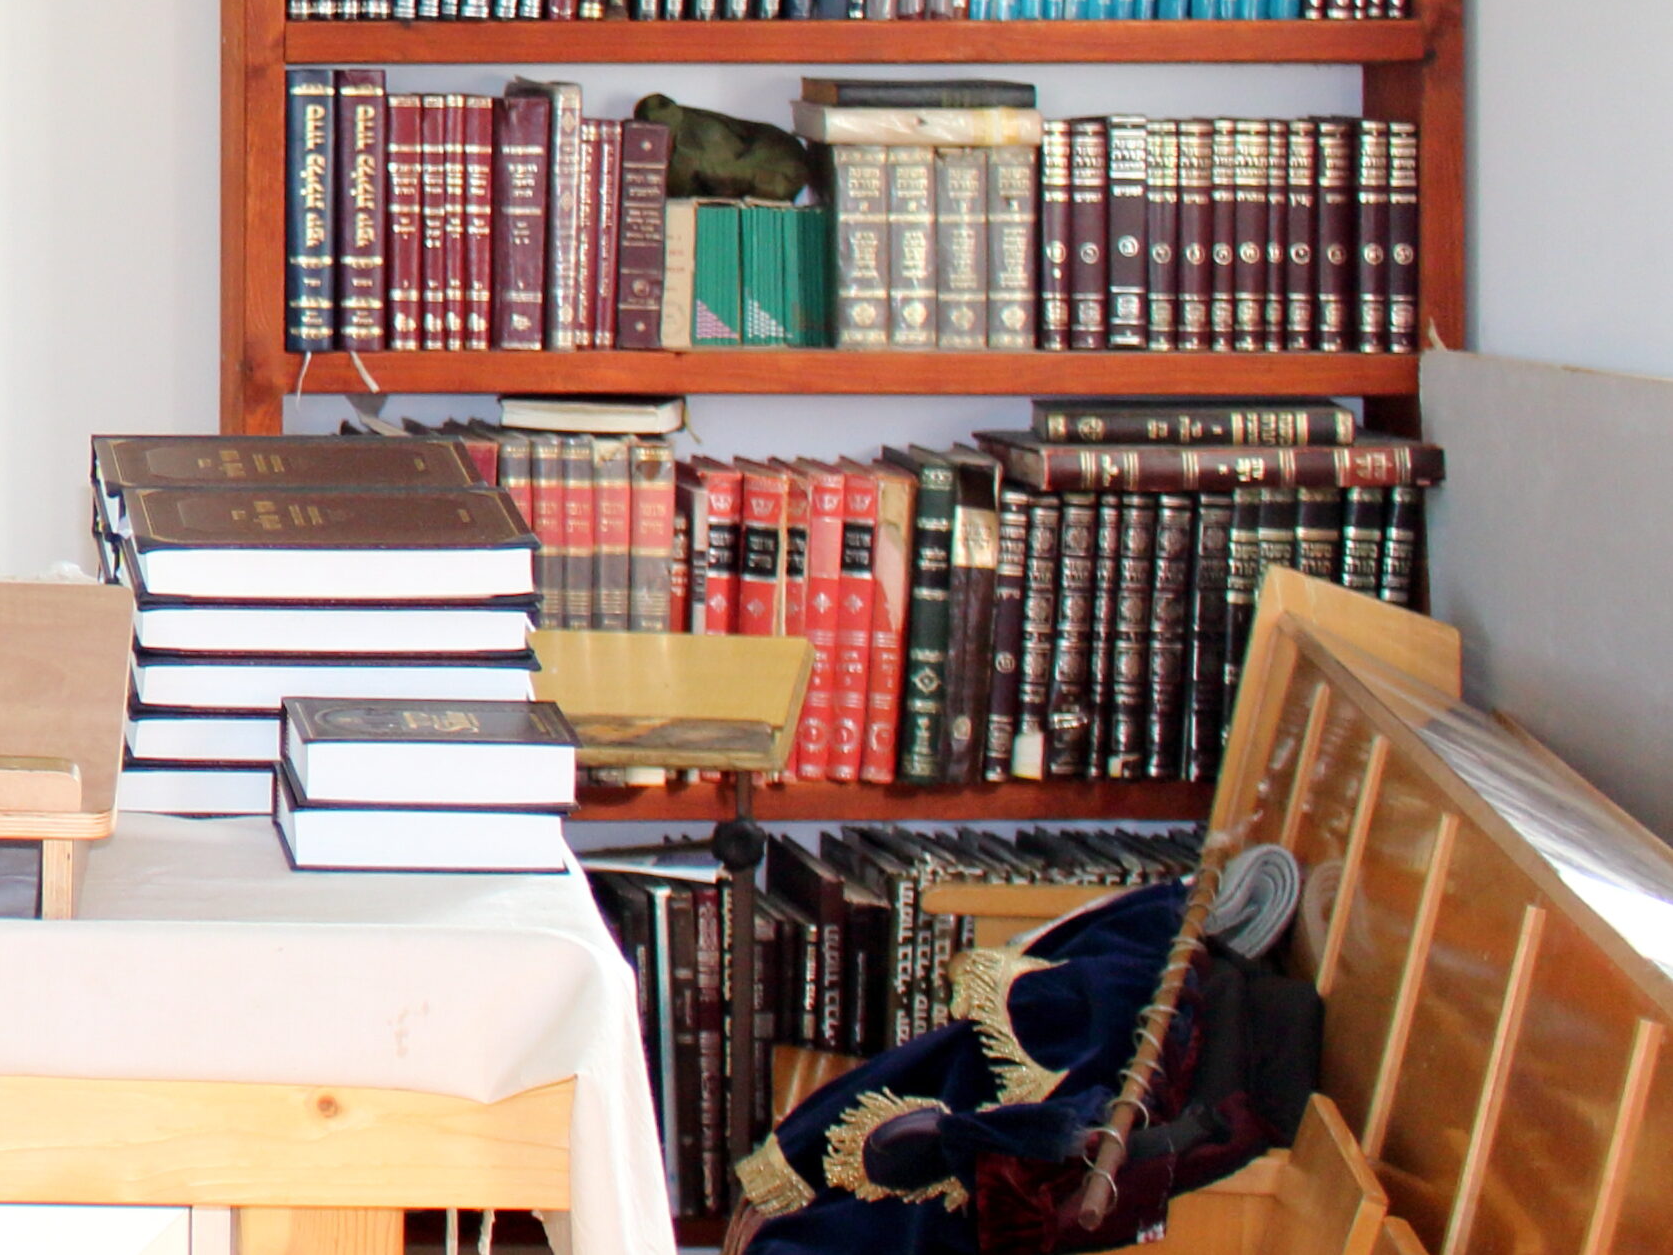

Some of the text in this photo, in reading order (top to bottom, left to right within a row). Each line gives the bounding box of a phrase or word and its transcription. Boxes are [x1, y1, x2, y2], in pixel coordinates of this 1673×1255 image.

[300, 104, 326, 248] סדור כלילת יופי
[350, 104, 376, 248] סדור כלילת יופי
[896, 881, 915, 941] תלמוד
[822, 924, 842, 1039] תלמוד בבלי
[897, 945, 914, 993] בבלי
